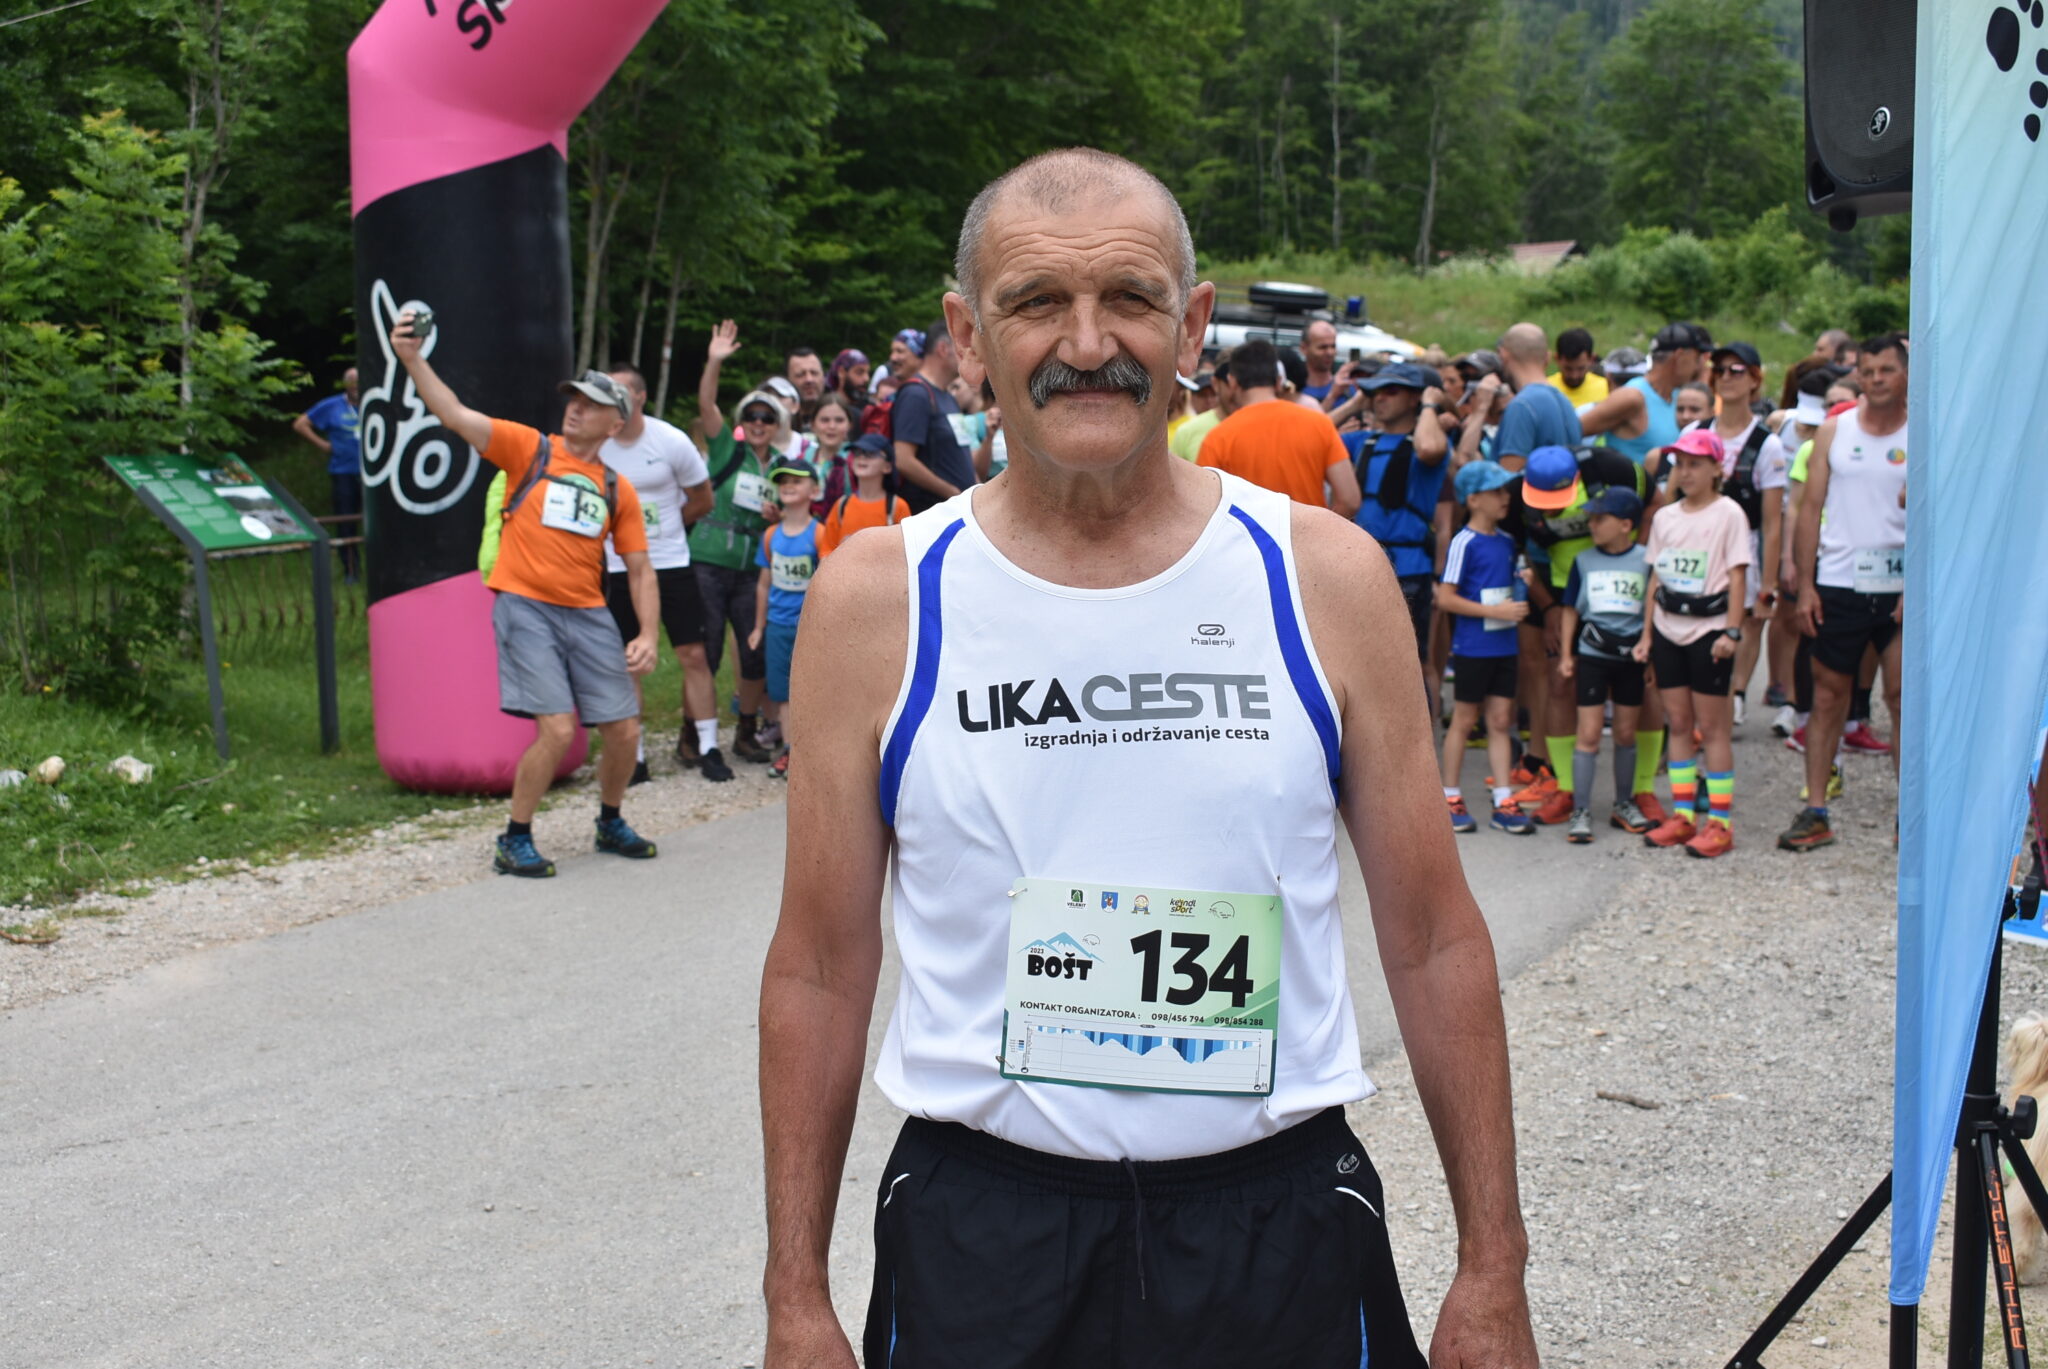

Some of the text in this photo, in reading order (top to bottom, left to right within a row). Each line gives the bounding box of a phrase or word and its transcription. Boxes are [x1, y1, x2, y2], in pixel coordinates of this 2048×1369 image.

[1673, 556, 1699, 576] 127
[1886, 558, 1903, 574] 14
[1613, 580, 1639, 596] 126
[1024, 725, 1270, 750] izgradnja i održavanje cesta
[1028, 952, 1093, 981] BOŠT
[1130, 929, 1254, 1008] 134
[1020, 1000, 1063, 1013] KONTAKT
[1065, 1005, 1136, 1020] ORGANIZATORA
[1151, 1012, 1188, 1023] 098/456
[1189, 1014, 1204, 1024] 794
[1214, 1016, 1248, 1026] 098/854
[1249, 1017, 1264, 1027] 288
[1988, 1181, 2025, 1350] ATHLETIC
